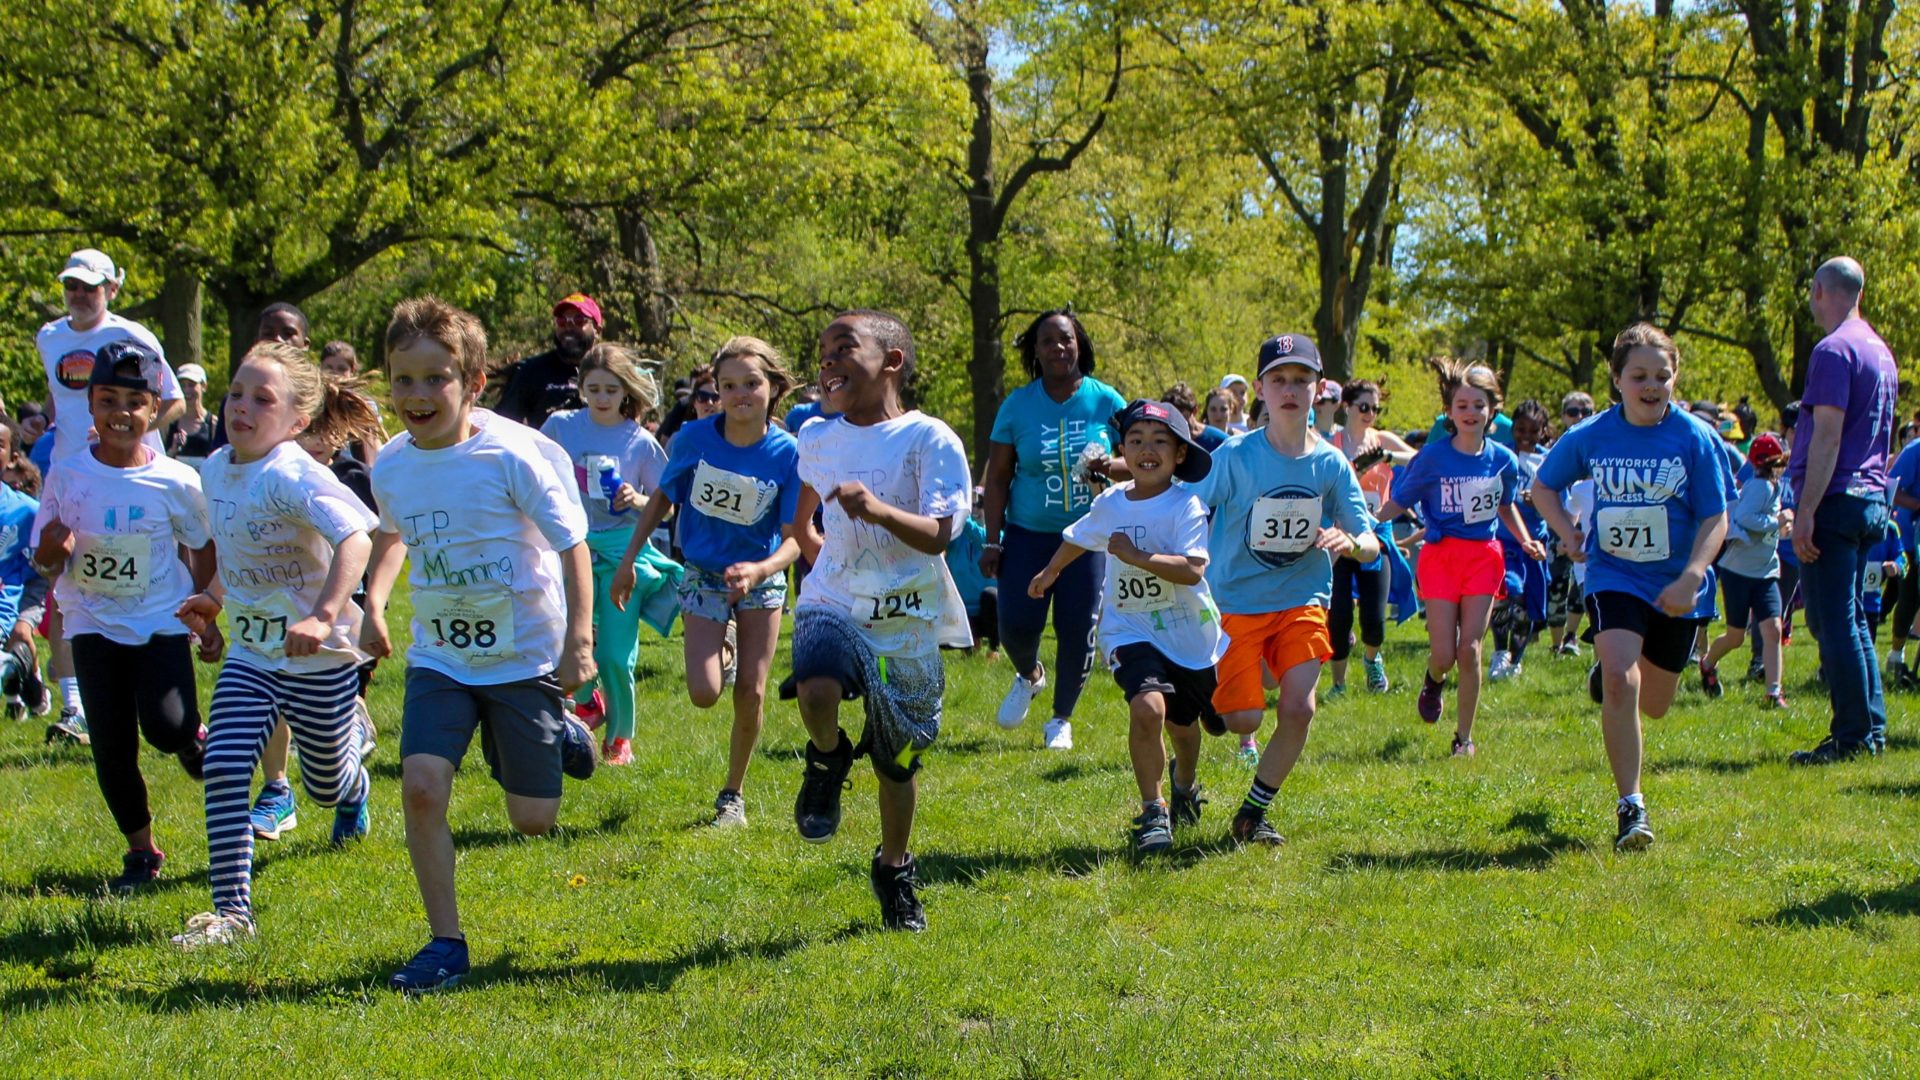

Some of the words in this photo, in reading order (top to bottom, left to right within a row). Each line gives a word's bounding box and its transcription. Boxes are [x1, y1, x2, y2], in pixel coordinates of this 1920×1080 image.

[1040, 424, 1063, 507] TOMMY
[1069, 420, 1089, 508] HILER
[1589, 458, 1657, 468] PLAYWORKS
[1440, 484, 1462, 506] RU
[1592, 467, 1653, 496] RUN
[701, 483, 742, 512] 321
[404, 510, 450, 547] J.P.
[1263, 518, 1310, 540] 312
[1609, 526, 1655, 549] 371
[83, 553, 138, 581] 324
[423, 549, 514, 587] Manning
[1117, 576, 1162, 600] 305
[869, 591, 923, 621] 124
[236, 616, 287, 643] 277
[431, 619, 497, 649] 188
